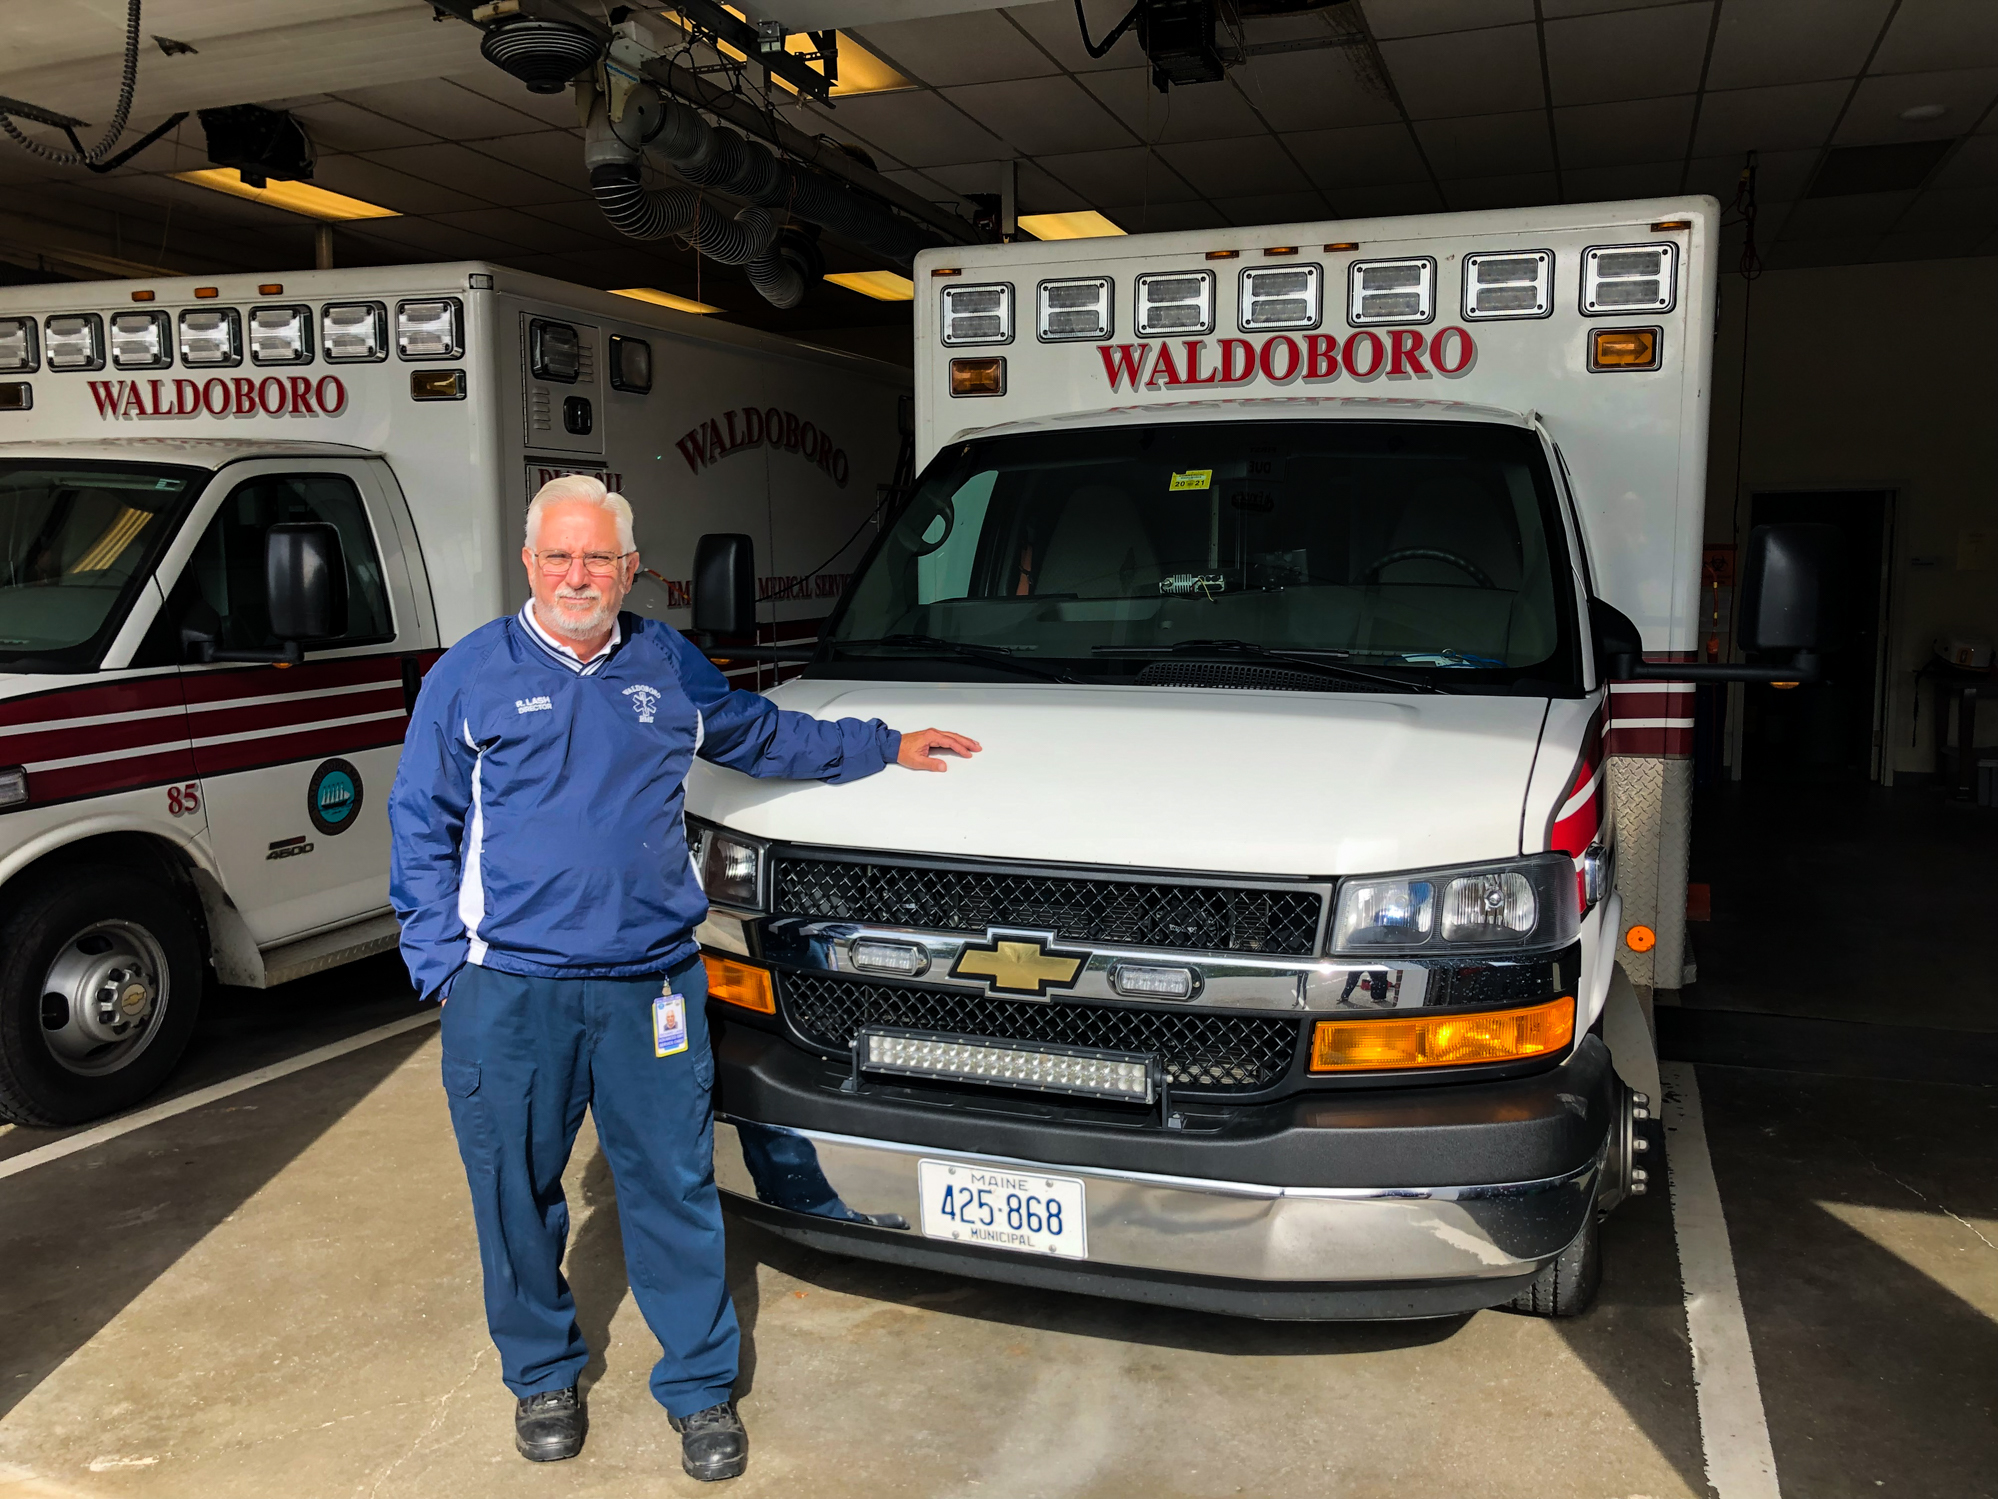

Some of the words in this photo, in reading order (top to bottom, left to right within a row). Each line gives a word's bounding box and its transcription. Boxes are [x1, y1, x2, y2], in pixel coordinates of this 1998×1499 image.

[1097, 327, 1475, 391] WALDOBORO
[87, 376, 348, 420] WALDOBORO
[676, 406, 849, 486] WALDOBORO
[757, 576, 813, 601] MEDICAL
[517, 703, 553, 714] DIRECTOR
[167, 782, 200, 817] 85
[971, 1174, 1028, 1191] MAINE
[971, 1228, 1036, 1248] MUNICIPAL
